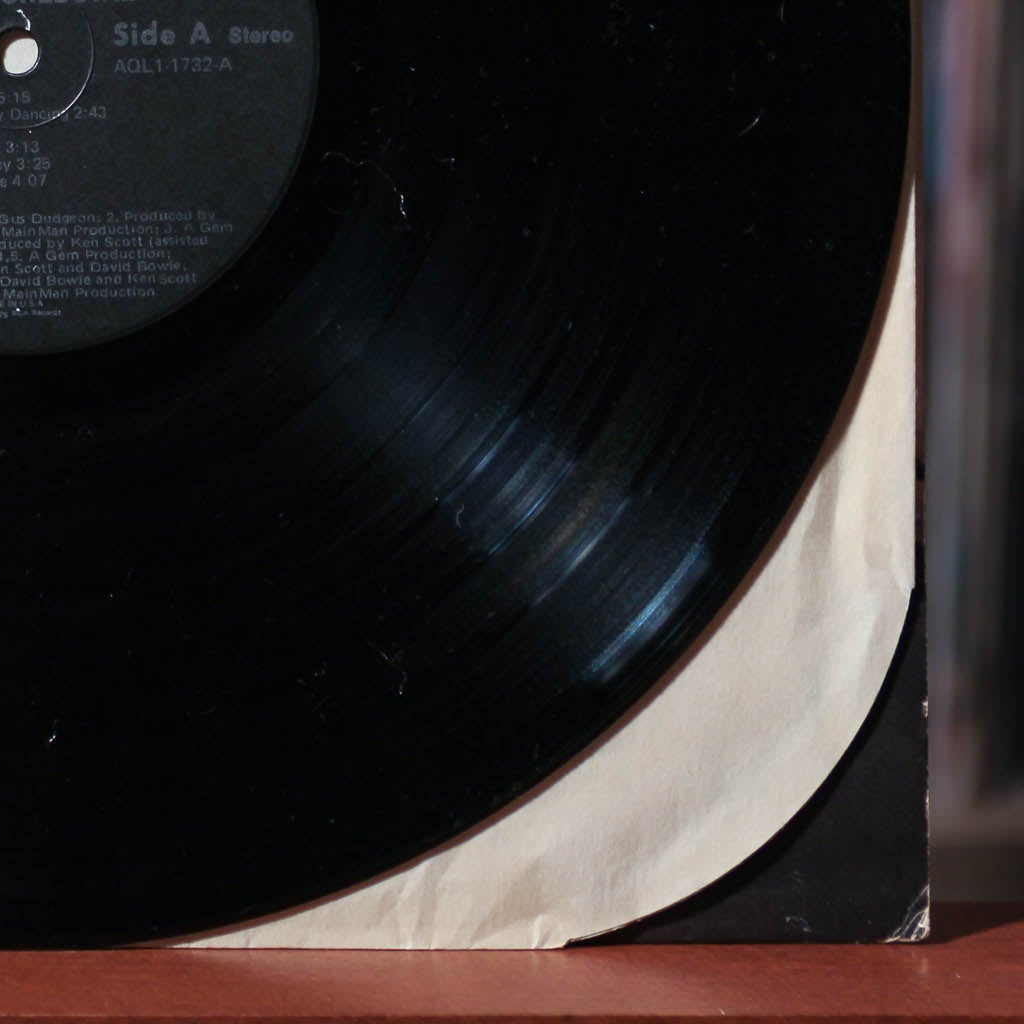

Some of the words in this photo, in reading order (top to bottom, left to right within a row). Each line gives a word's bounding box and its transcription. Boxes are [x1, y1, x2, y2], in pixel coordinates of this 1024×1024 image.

[113, 20, 177, 47] Side
[190, 21, 212, 45] A
[229, 25, 295, 45] Stereo
[73, 105, 107, 120] 2:43
[6, 140, 41, 153] 3:13
[16, 156, 51, 171] 3:25
[106, 212, 119, 223] 2.
[124, 210, 192, 223] Produced
[197, 209, 216, 221] by
[73, 224, 159, 236] Production;
[200, 221, 233, 233] Gem
[47, 238, 65, 251] by
[71, 237, 99, 248] Ken
[104, 236, 142, 248] Scott
[149, 235, 209, 248] (assisted
[29, 251, 40, 261] A
[45, 250, 80, 261] Gem
[85, 249, 171, 260] Production;
[15, 263, 53, 274] Scott
[58, 262, 84, 273] and
[90, 261, 131, 273] David
[0, 276, 41, 287] David
[46, 275, 91, 286] Bowie
[96, 274, 122, 285] and
[128, 273, 156, 284] Ken
[160, 272, 197, 284] Scott
